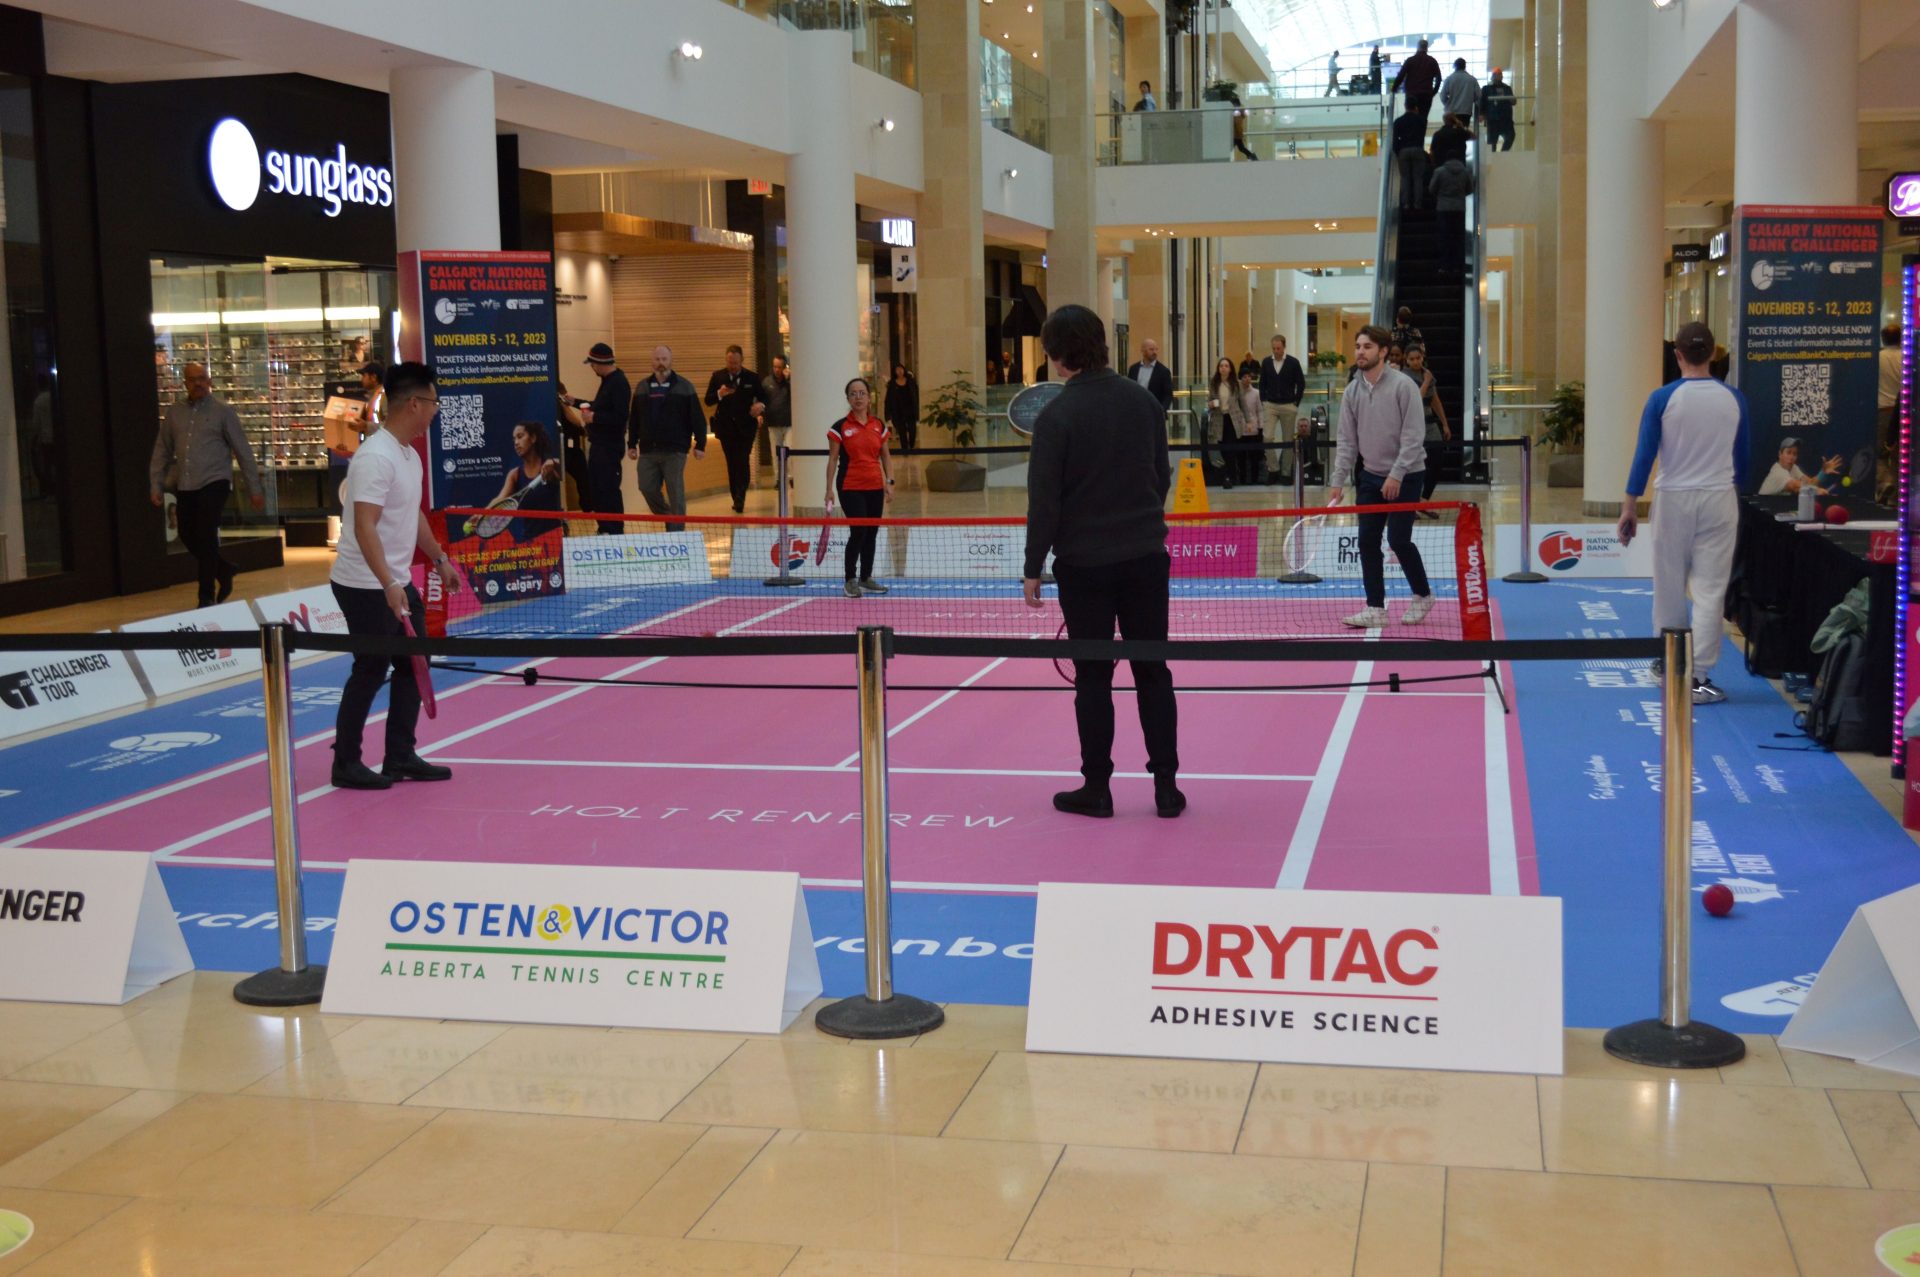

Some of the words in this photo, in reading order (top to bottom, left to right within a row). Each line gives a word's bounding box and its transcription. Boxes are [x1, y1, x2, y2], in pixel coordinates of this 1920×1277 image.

[266, 143, 392, 217] sunglass
[1748, 224, 1809, 237] CALGARY
[1812, 225, 1878, 238] NATIONAL
[1709, 232, 1724, 260] ALDO
[1748, 238, 1786, 252] BANK
[1791, 239, 1878, 252] CHALLENGER
[429, 266, 484, 278] CALGARY
[488, 267, 546, 278] NATIONAL
[429, 279, 466, 291] BANK
[469, 280, 547, 291] CHALLENGER
[1748, 302, 1805, 315] NOVEMBER
[1807, 302, 1815, 315] 5
[1825, 302, 1841, 317] 12,
[1846, 302, 1872, 315] 2023
[1748, 326, 1778, 335] TICKETS
[1779, 326, 1800, 335] FROM
[1802, 325, 1817, 336] $20
[1818, 326, 1831, 334] ON
[1832, 326, 1850, 334] SALE
[1851, 325, 1872, 334] NOW
[434, 334, 488, 346] NOVEMBER
[489, 334, 497, 346] 5
[505, 333, 519, 346] 12,
[523, 333, 546, 345] 2023
[1747, 340, 1766, 348] Event
[1774, 339, 1792, 348] ticket
[1794, 339, 1833, 348] information
[1834, 338, 1864, 346] available
[436, 355, 464, 364] TICKETS
[465, 354, 486, 363] FROM
[487, 354, 501, 363] $20
[500, 354, 512, 362] ON
[512, 353, 528, 361] SALE
[529, 353, 548, 361] NOW
[1747, 350, 1873, 361] Calgary.NationalBankChallenger.com
[436, 366, 454, 375] Event
[461, 365, 479, 374] ticket
[481, 365, 515, 374] information
[516, 364, 540, 373] available
[542, 364, 549, 372] at
[436, 375, 549, 387] Calgary.NationalBankChallenger.com
[457, 458, 476, 466] OSTEN
[481, 456, 502, 464] VICTOR
[467, 550, 490, 563] STARS
[491, 549, 501, 559] OF
[503, 546, 543, 559] TOMORROW
[572, 548, 623, 561] OSTEN
[635, 544, 689, 558] VICTOR
[969, 544, 1005, 556] CORE
[1164, 544, 1238, 559] ENFREW
[1586, 544, 1609, 552] BANK
[474, 563, 488, 575] ARE
[489, 560, 517, 573] COMING
[519, 559, 528, 570] TO
[529, 556, 560, 569] CALGARY
[506, 579, 543, 593] calgary
[31, 653, 111, 684] CHALLENGER
[187, 668, 205, 679] MORE
[205, 663, 221, 674] THAN
[221, 657, 240, 670] PRINT
[40, 681, 79, 702] TOUR
[530, 804, 689, 819] HOLT
[708, 808, 1014, 828] RENFREW
[0, 889, 85, 922] NGER
[390, 900, 536, 938] OSTEN
[543, 910, 562, 934] &
[572, 906, 729, 946] VICTOR
[1152, 921, 1440, 987] DRYTAC
[381, 960, 486, 979] ALBERTA
[511, 965, 600, 984] TENNIS
[626, 970, 725, 990] CENTRE
[1150, 1005, 1295, 1029] ADHESIVE
[1313, 1012, 1440, 1036] SCIENCE
